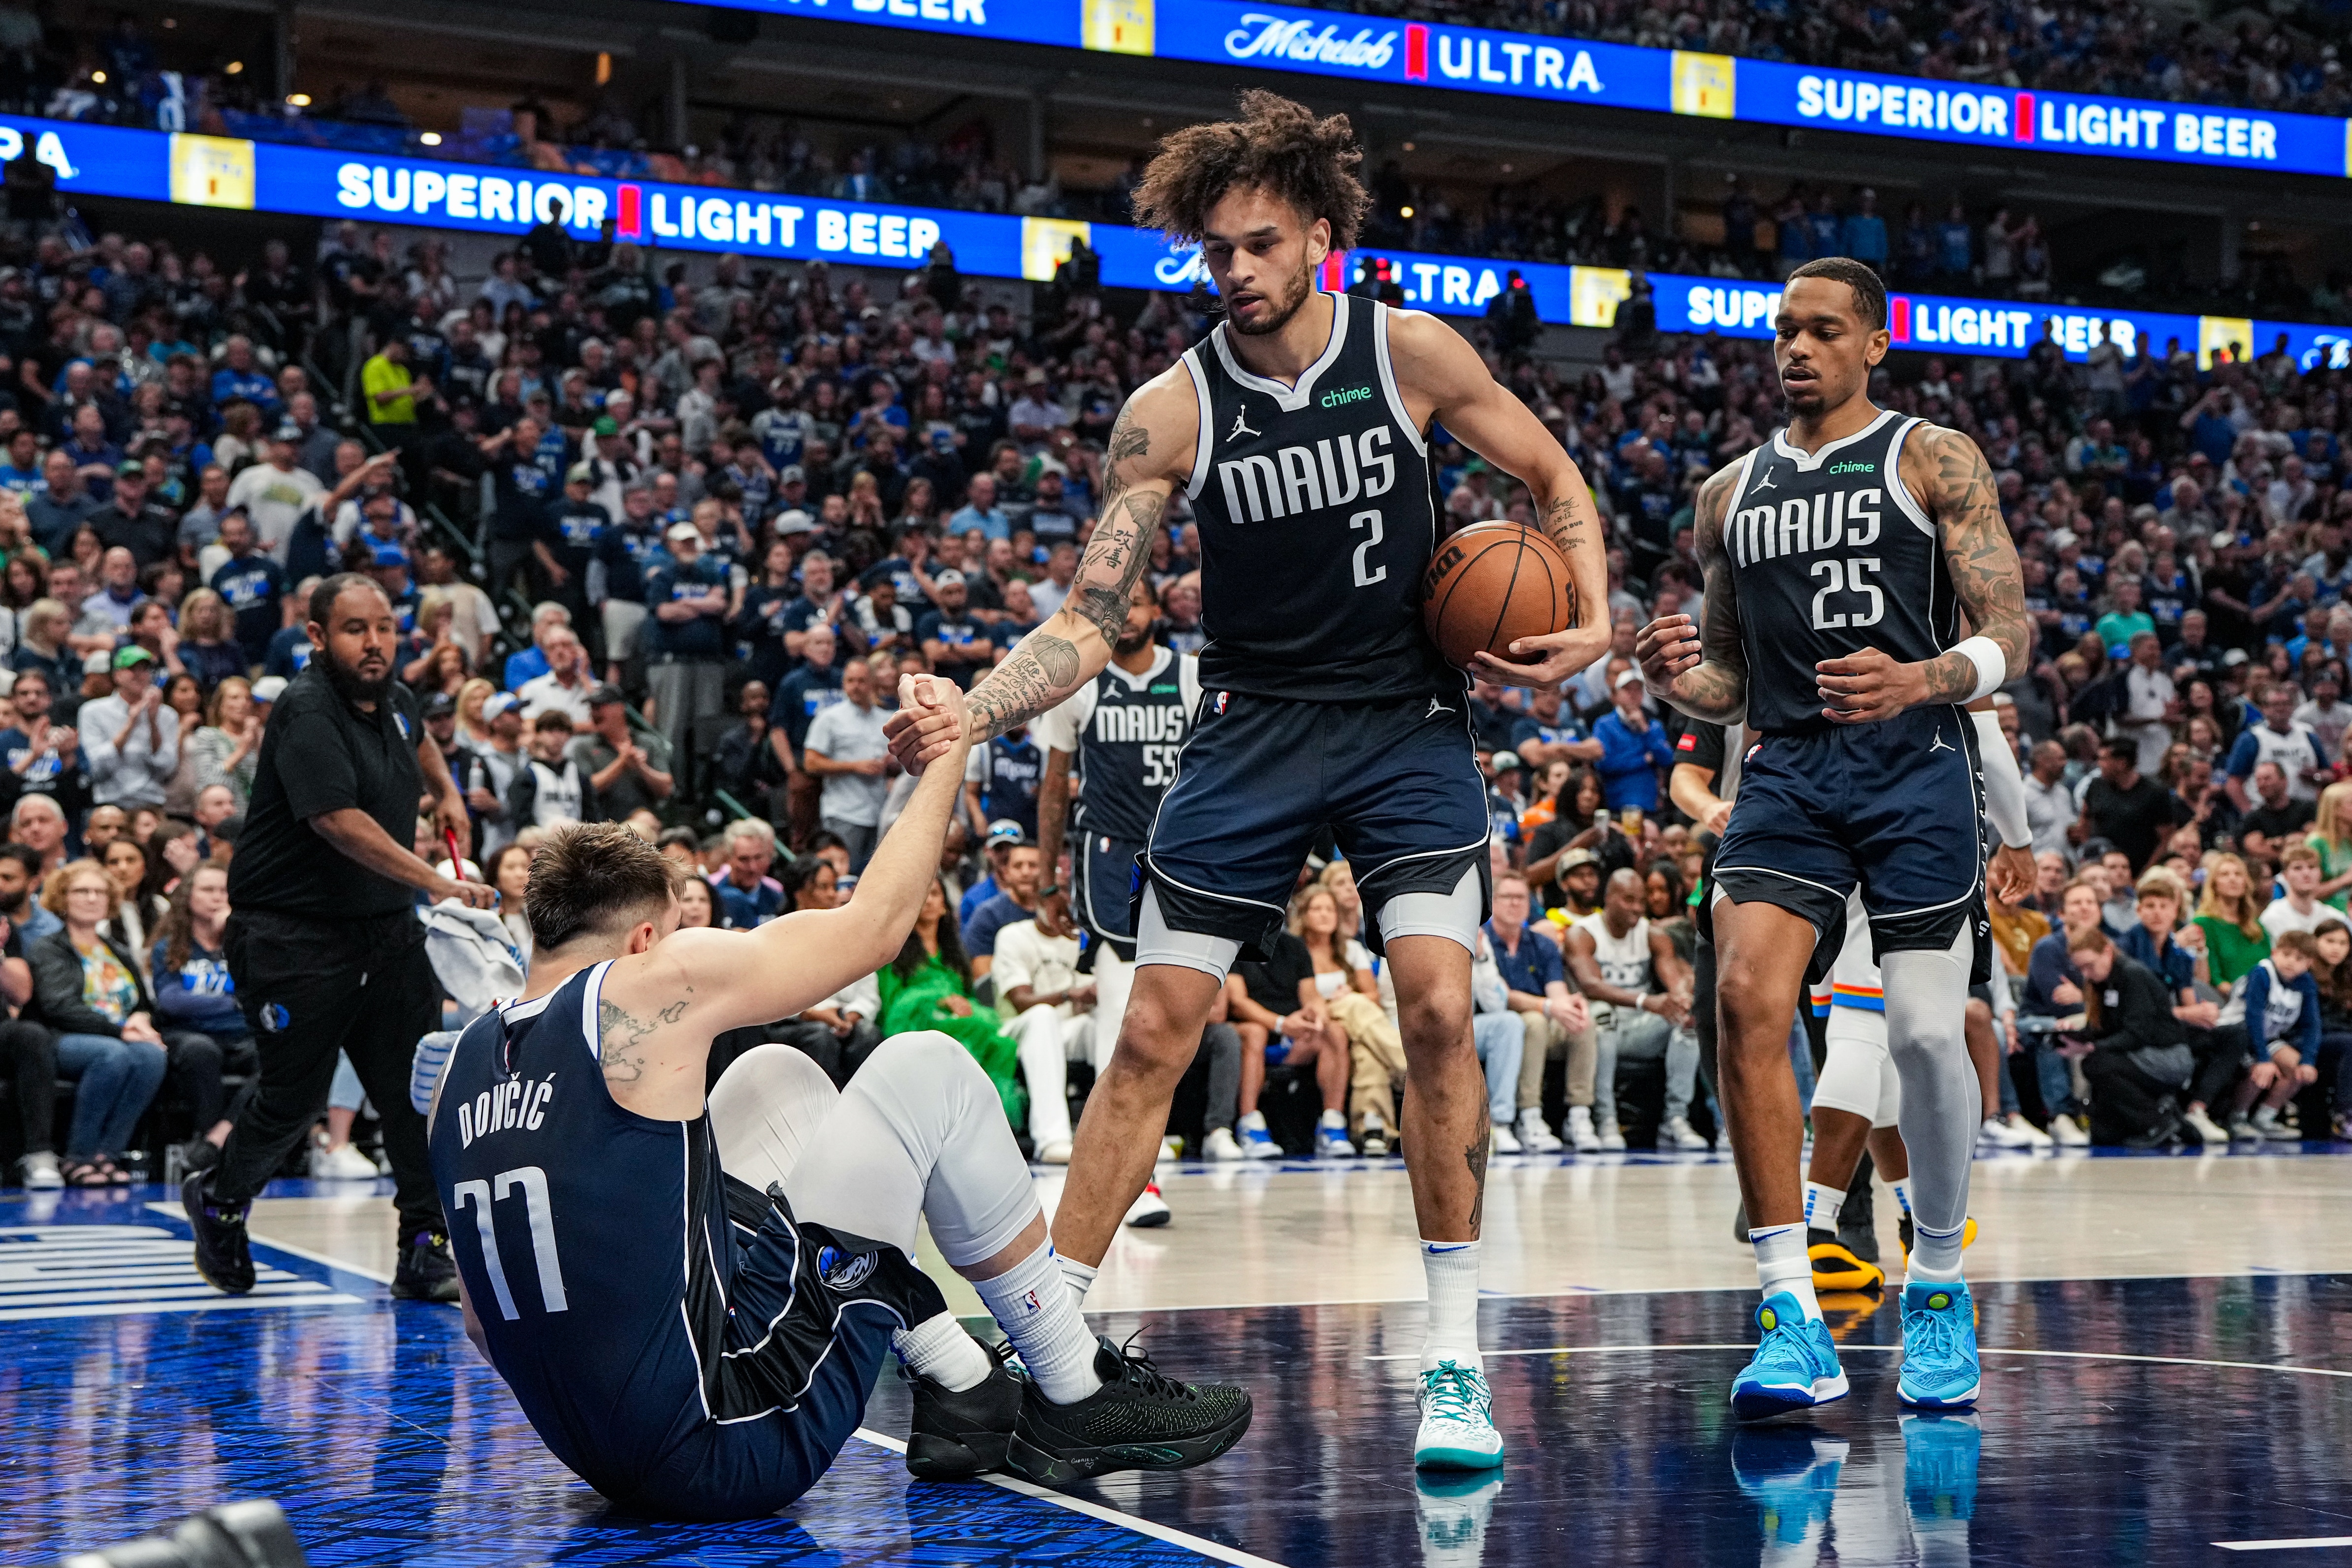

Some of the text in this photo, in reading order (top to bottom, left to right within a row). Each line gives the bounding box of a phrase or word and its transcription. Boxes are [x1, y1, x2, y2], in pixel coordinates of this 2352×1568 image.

[852, 0, 986, 25] ER
[1224, 13, 1600, 92] Michelob ULTRA
[1797, 75, 2277, 160] SUPERIOR LIGHT BEER
[336, 162, 608, 229] SUPERIOR
[651, 193, 804, 246] LIGHT
[1917, 304, 2031, 349] LIGHT
[1321, 384, 1372, 409] chime
[1218, 425, 1395, 524] MAVS
[1829, 461, 1874, 475] chime
[1349, 509, 1386, 588] 2
[1736, 488, 1881, 568] MAVS
[1810, 558, 1885, 630] 25
[1096, 704, 1184, 742] MAVS
[1143, 744, 1180, 786] 55
[458, 1072, 556, 1150] DONČIĆ
[454, 1166, 568, 1321] 77
